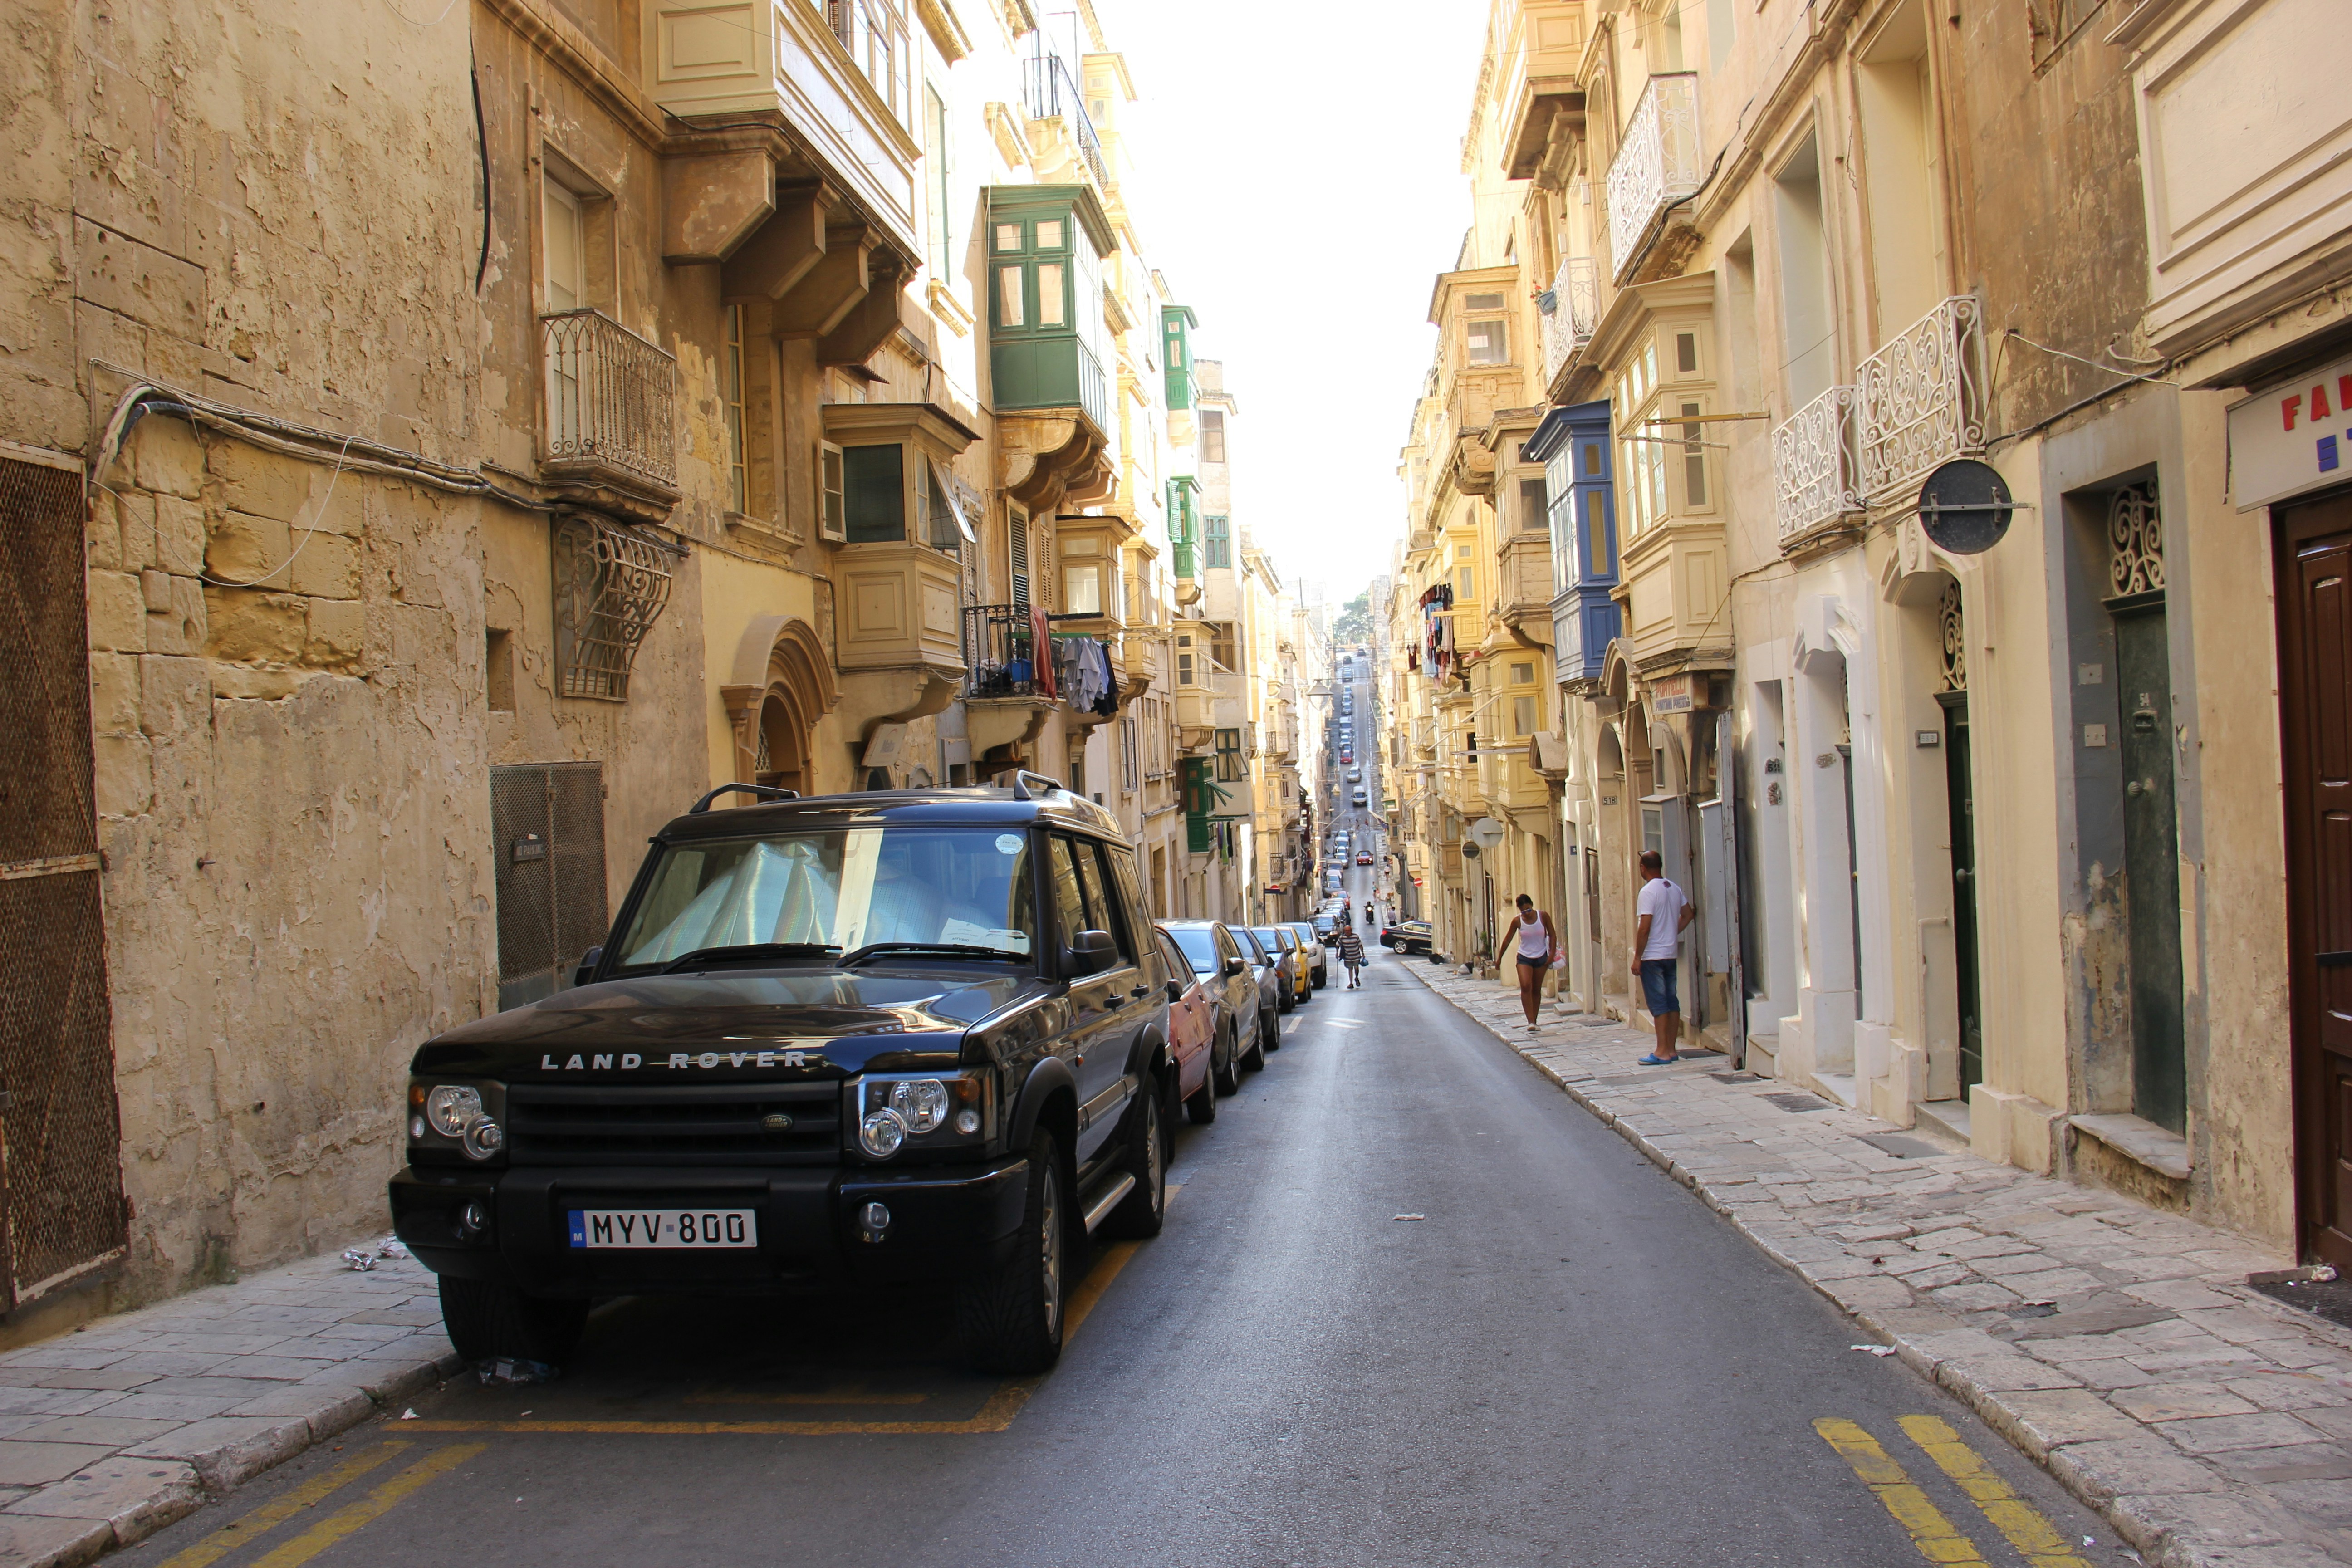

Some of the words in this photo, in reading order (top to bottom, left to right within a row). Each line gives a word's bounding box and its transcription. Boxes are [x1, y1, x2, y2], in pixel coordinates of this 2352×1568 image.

[541, 1054, 642, 1070] LAND
[669, 1051, 805, 1068] ROVER
[573, 1233, 583, 1241] M
[592, 1214, 661, 1243] MYV
[679, 1213, 745, 1243] 800
